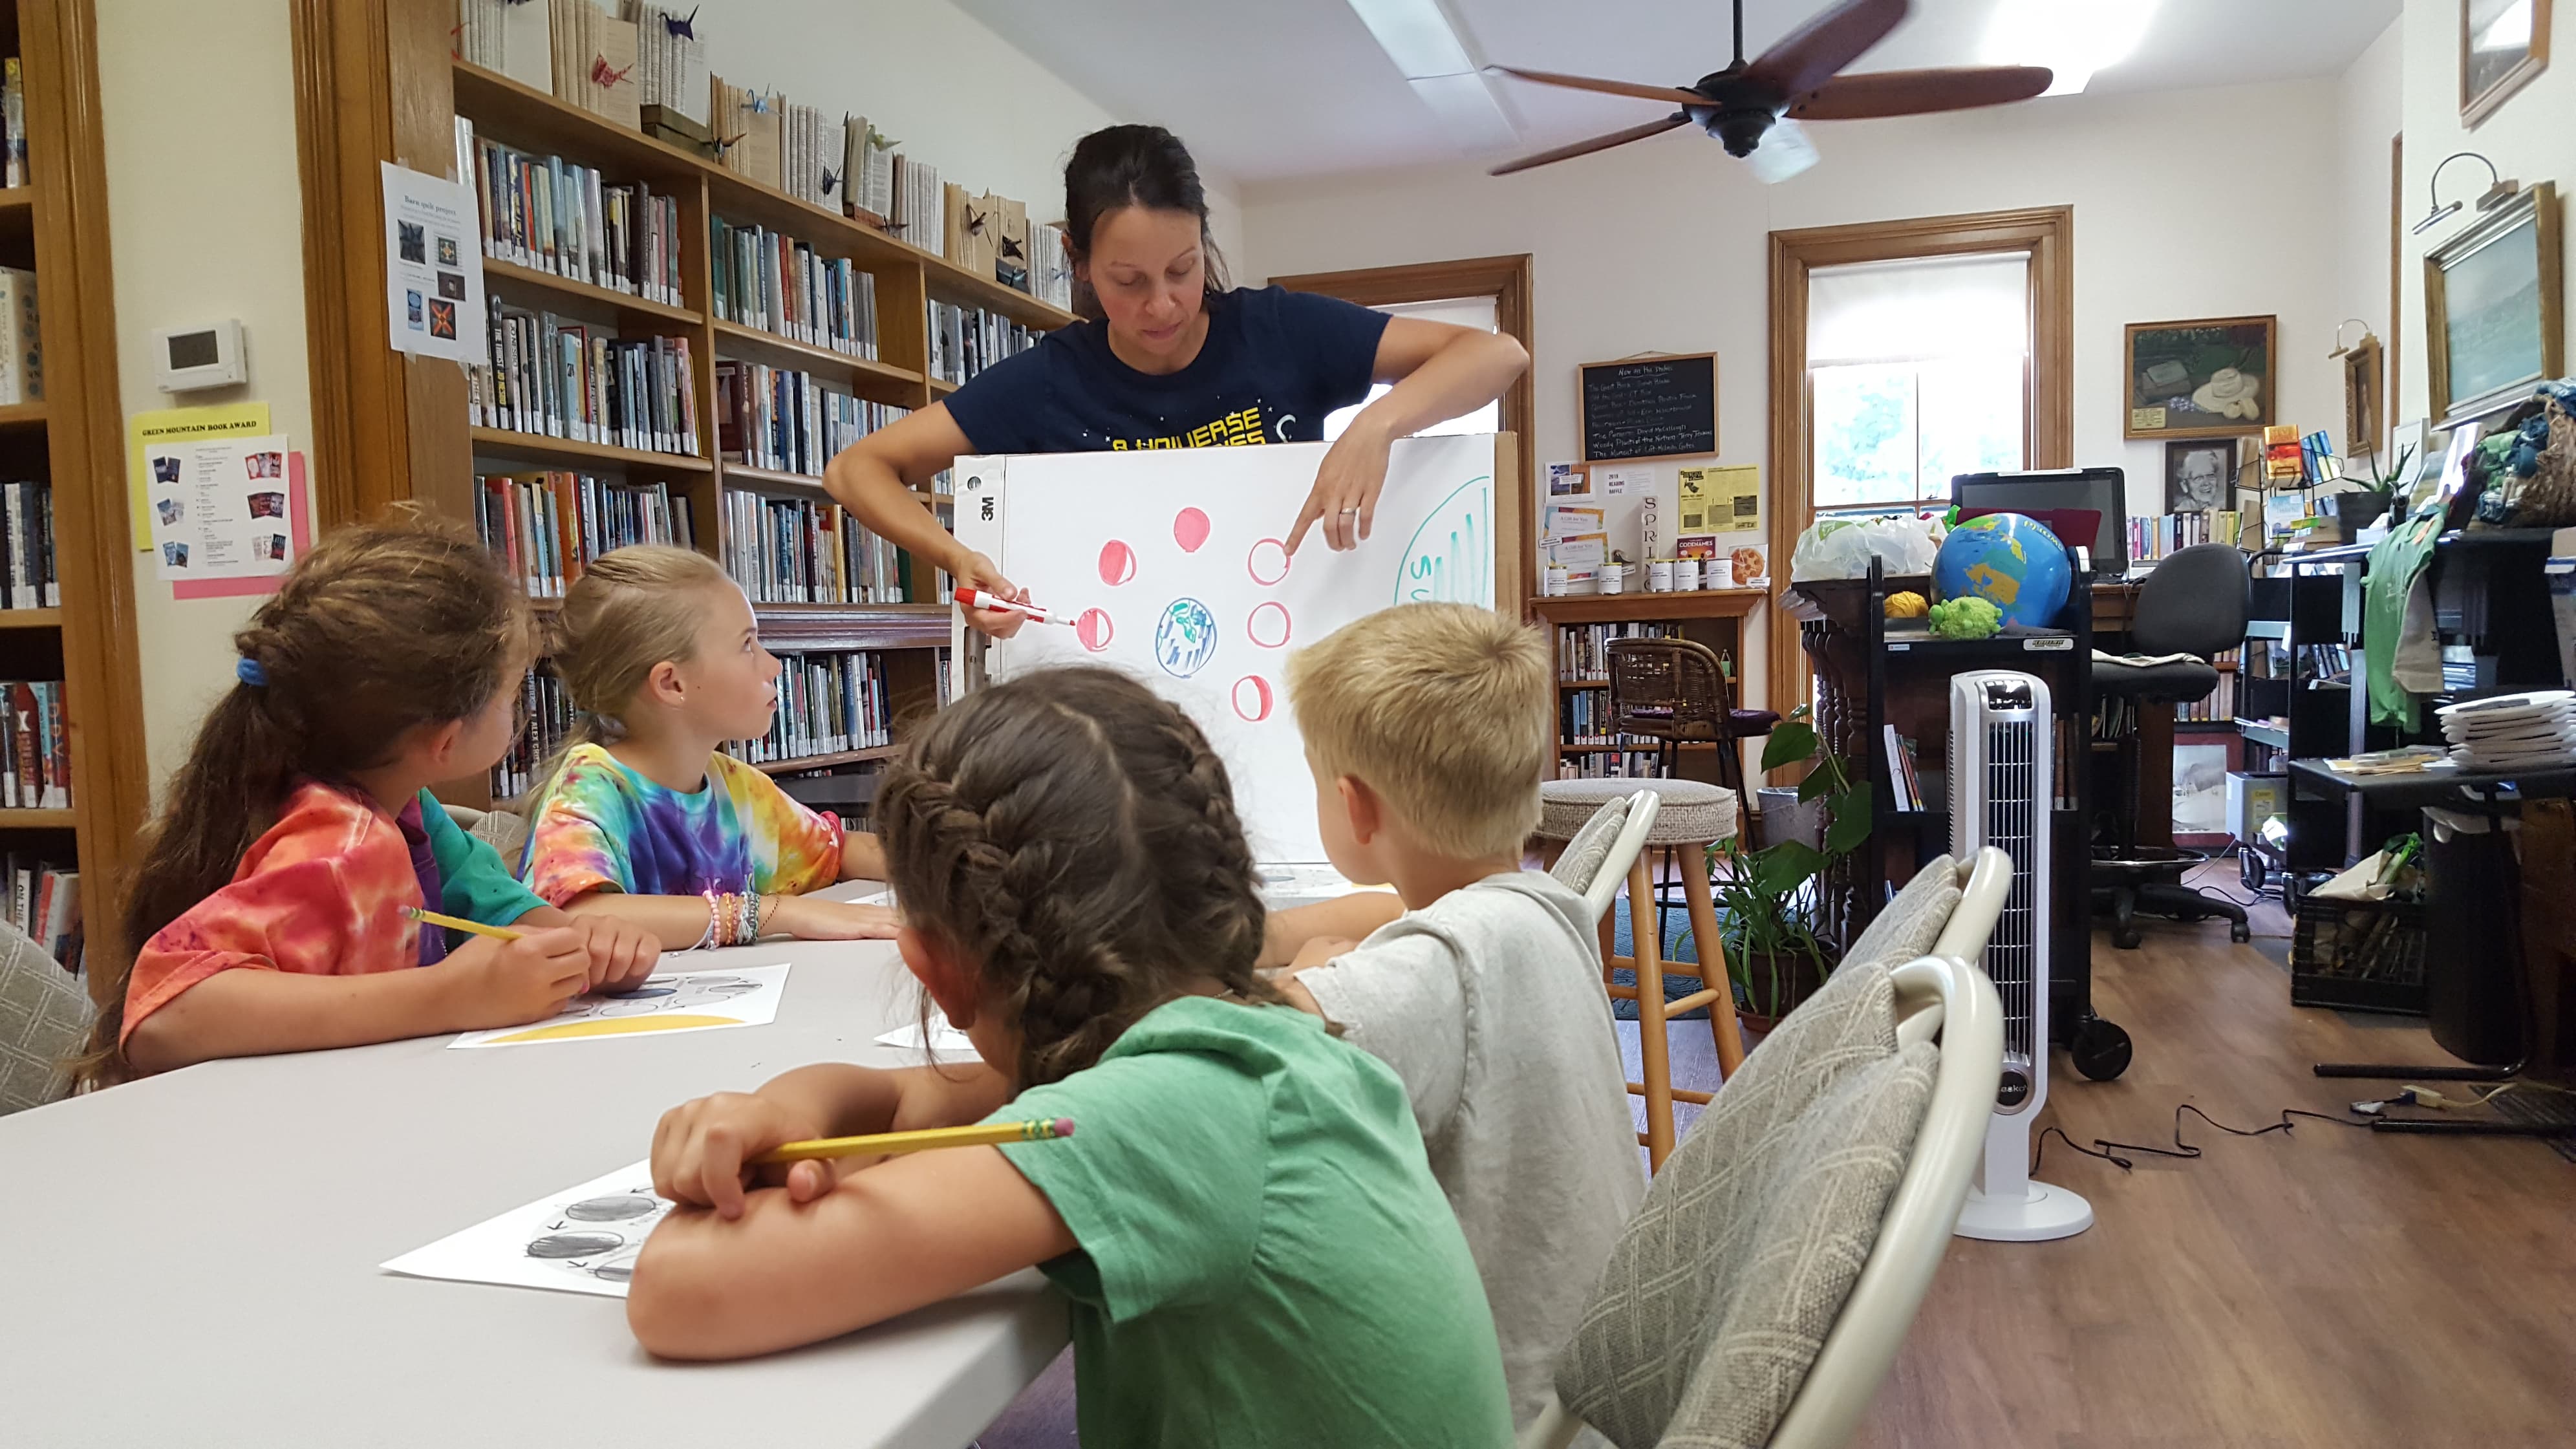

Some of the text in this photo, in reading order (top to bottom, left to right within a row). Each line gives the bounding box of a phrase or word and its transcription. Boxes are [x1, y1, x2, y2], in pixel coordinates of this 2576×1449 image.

[404, 195, 456, 216] Barn quilt project
[166, 425, 206, 435] MOUNTAIN
[230, 421, 257, 429] AWARD
[982, 497, 994, 521] 3M
